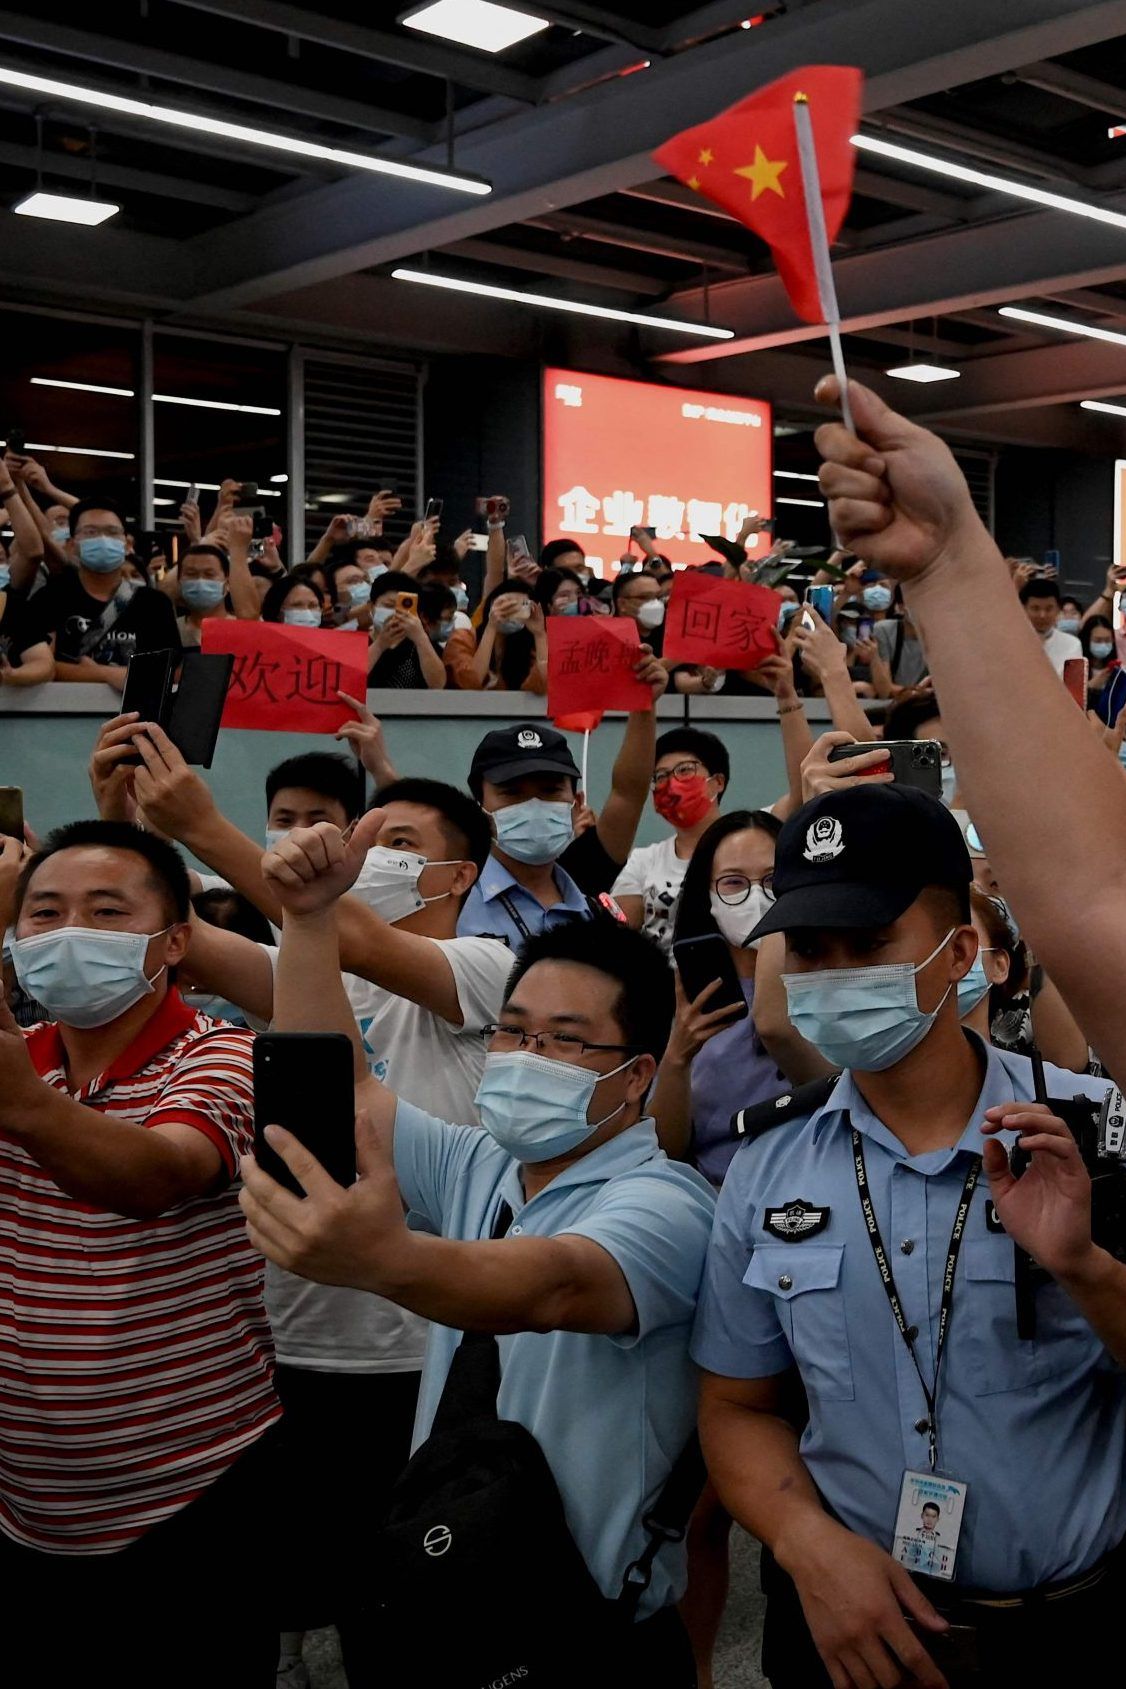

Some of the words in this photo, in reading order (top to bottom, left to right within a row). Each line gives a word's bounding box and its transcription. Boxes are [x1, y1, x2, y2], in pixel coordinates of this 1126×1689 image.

[682, 599, 767, 652] 回家
[229, 650, 342, 705] 欢迎
[855, 1155, 866, 1186] POLICE
[862, 1197, 877, 1234] POLICE
[953, 1203, 968, 1240] POLICE
[874, 1246, 891, 1283] POLICE
[944, 1254, 956, 1292] POLICE
[890, 1295, 905, 1333] POLICE
